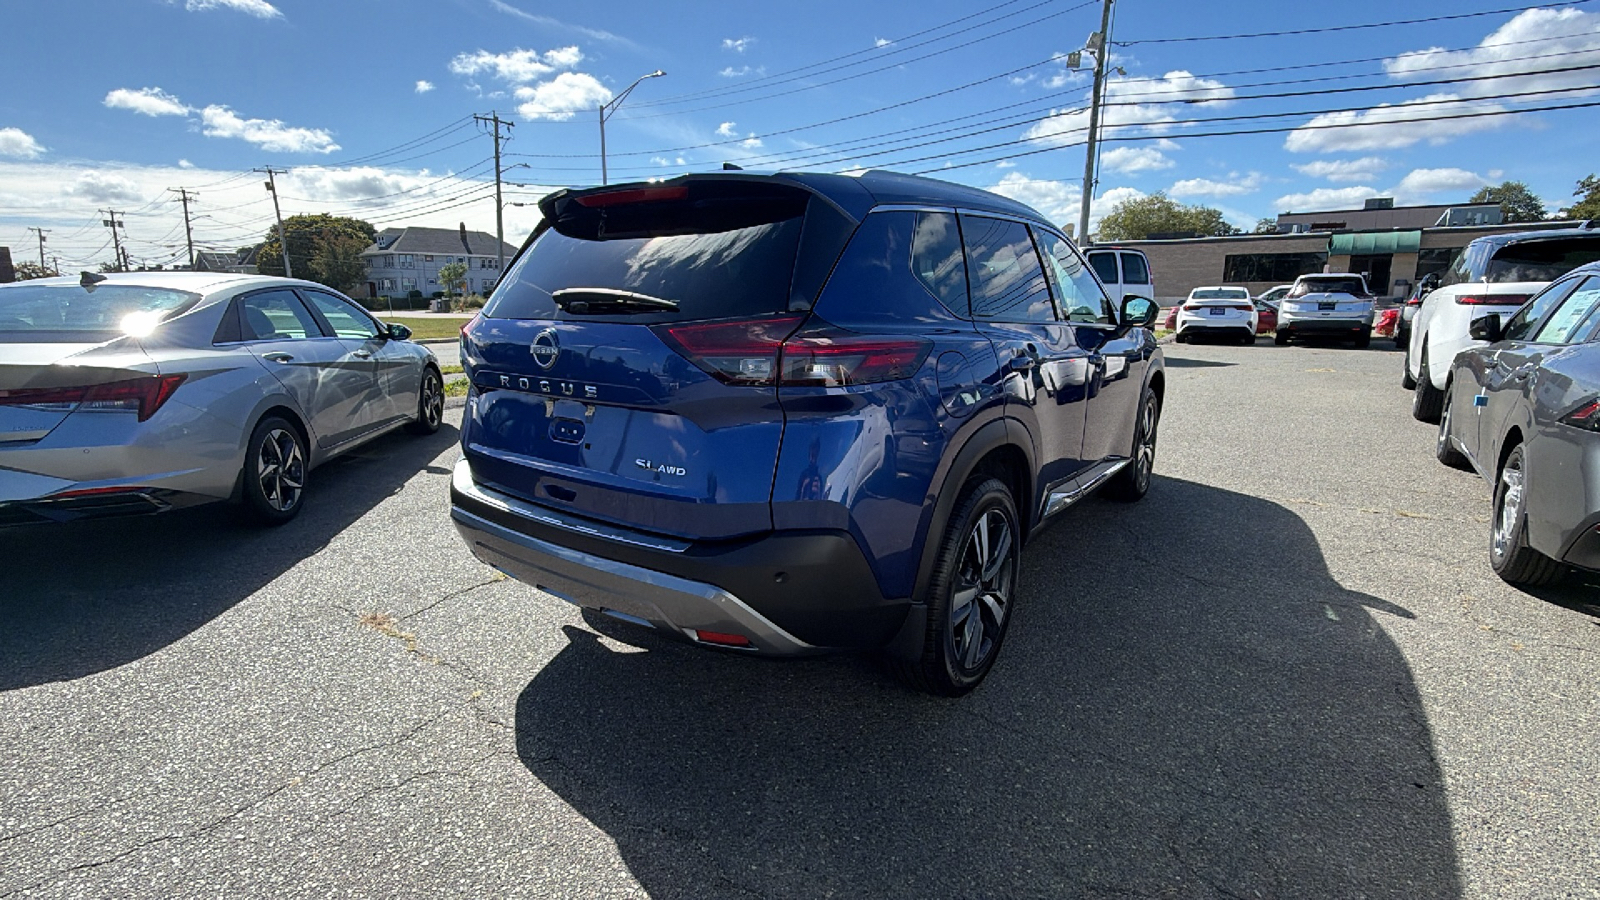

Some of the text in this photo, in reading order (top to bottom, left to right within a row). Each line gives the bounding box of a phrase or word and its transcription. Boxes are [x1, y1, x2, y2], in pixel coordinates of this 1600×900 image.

[531, 345, 558, 355] ISSAN
[500, 374, 597, 398] ROGUE
[658, 464, 686, 476] AWD
